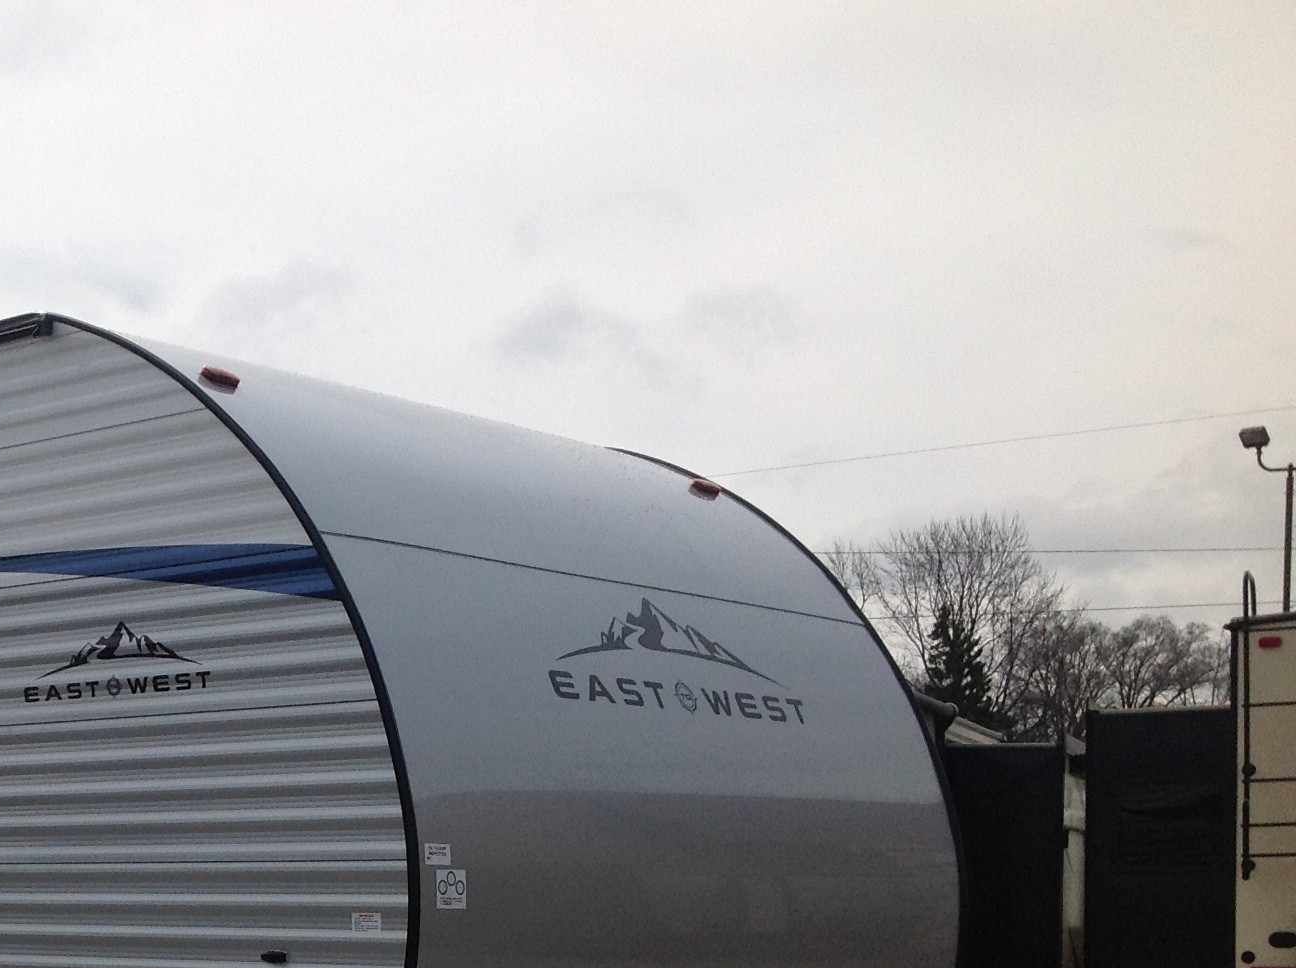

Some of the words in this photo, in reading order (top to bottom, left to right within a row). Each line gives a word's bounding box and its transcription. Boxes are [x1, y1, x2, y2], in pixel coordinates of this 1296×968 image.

[24, 681, 99, 703] EAST
[127, 671, 211, 694] WEST
[548, 670, 664, 709] EAST
[701, 687, 805, 725] WEST
